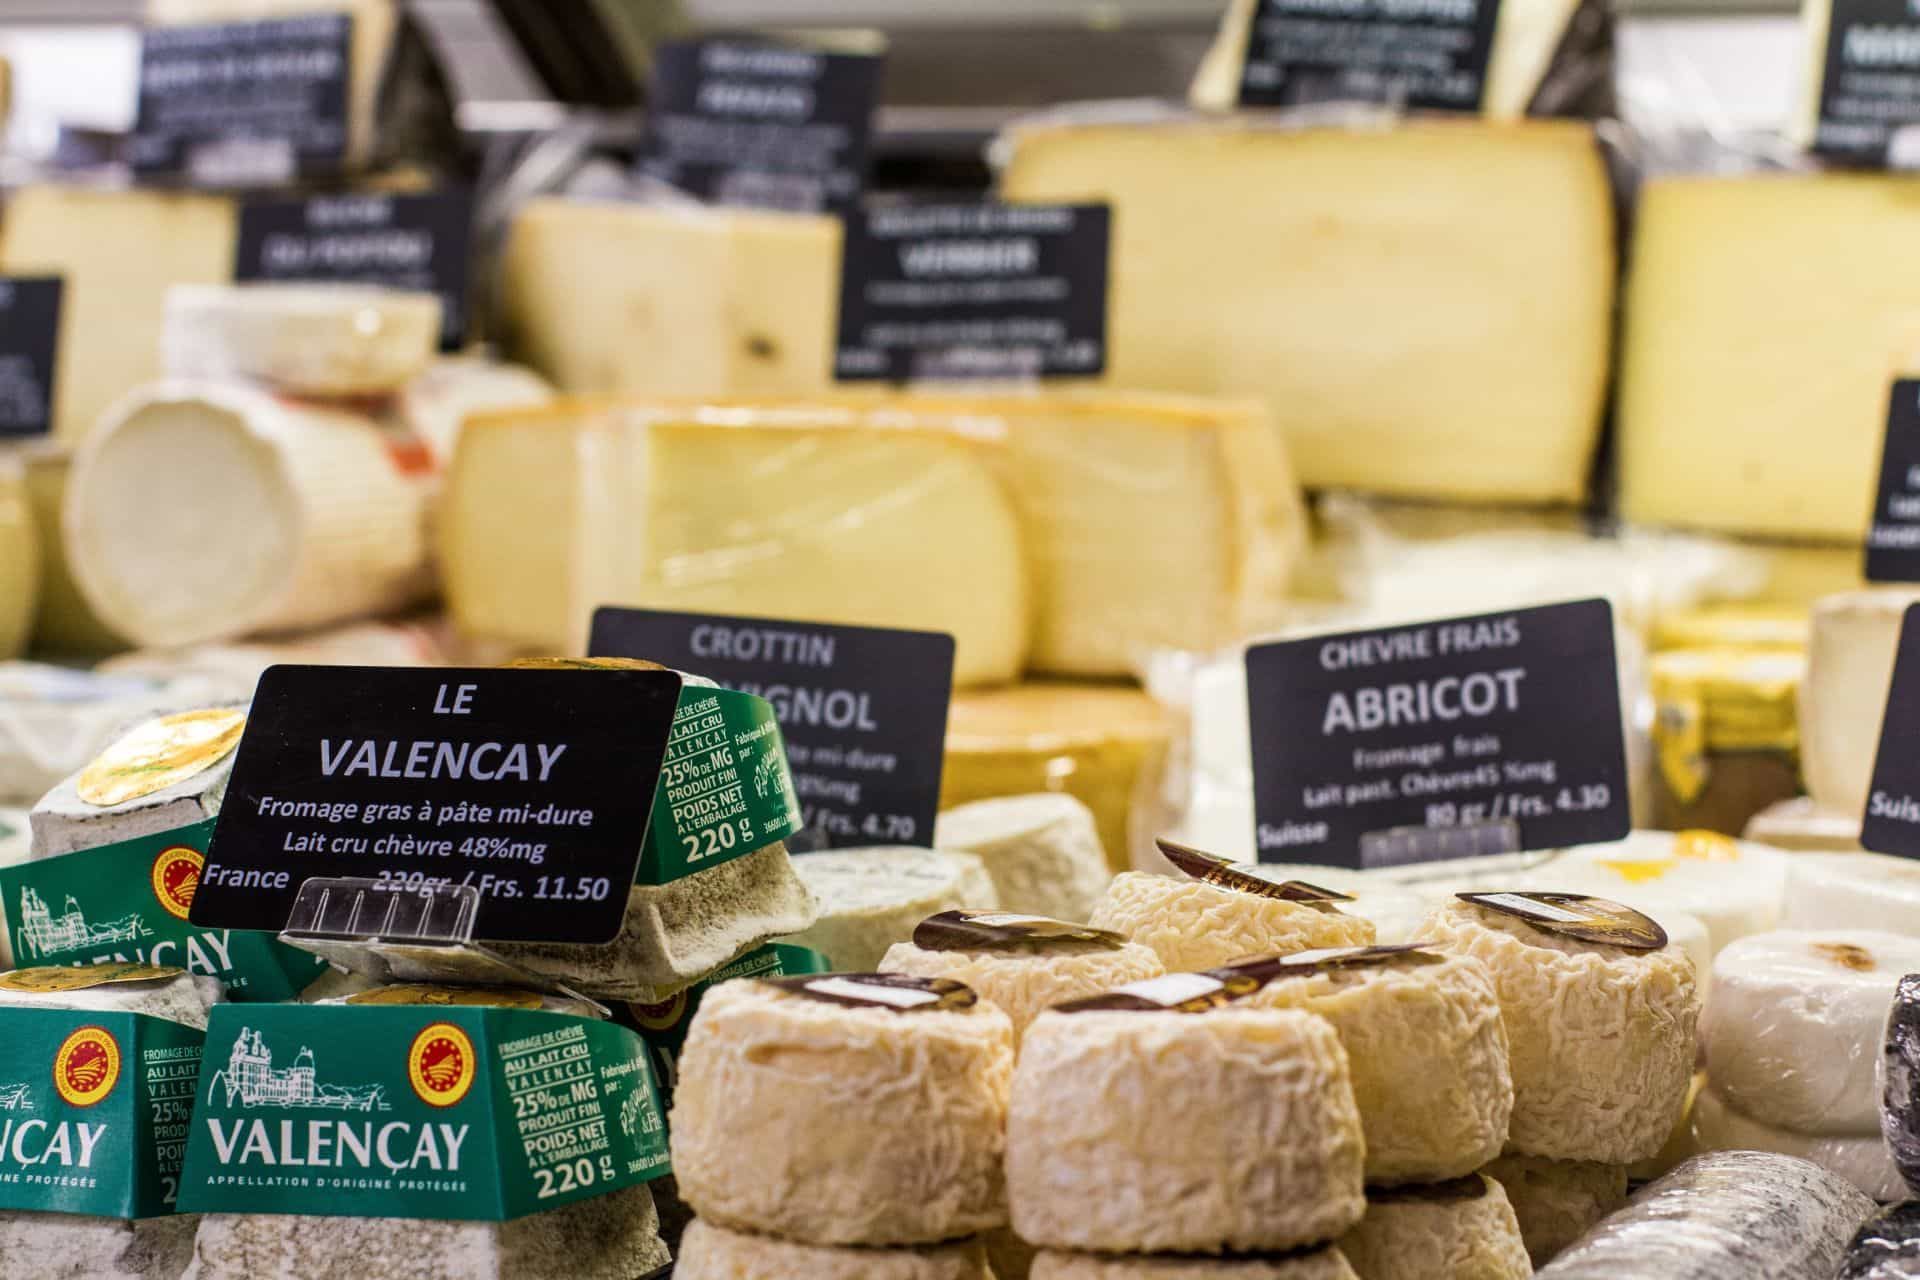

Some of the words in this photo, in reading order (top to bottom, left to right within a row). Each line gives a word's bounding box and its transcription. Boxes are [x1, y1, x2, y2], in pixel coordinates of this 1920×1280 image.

[690, 624, 835, 666] CROTTIN
[1438, 618, 1521, 656] FRAIS
[433, 683, 478, 715] LE
[685, 705, 695, 716] DE
[1322, 668, 1526, 734] ABRICOT
[674, 721, 699, 738] LAIT
[701, 713, 723, 729] CRU
[320, 739, 566, 781] VALENCAY
[667, 728, 728, 760] ALENÇAY
[662, 760, 700, 788] 25%
[701, 762, 712, 775] DE
[711, 747, 734, 771] MG
[667, 773, 717, 803] PRODUIT
[719, 768, 738, 783] FINI
[258, 796, 359, 823] Fromage
[362, 805, 412, 825] gras
[417, 799, 433, 822] à
[437, 800, 493, 826] pâte
[498, 802, 594, 826] mi-dure
[672, 795, 719, 823] POIDS
[719, 784, 743, 804] NET
[283, 831, 326, 853] Lait
[330, 836, 368, 854] cru
[373, 834, 453, 856] chèvre
[458, 837, 548, 865] 48%mg
[681, 822, 736, 863] 220
[739, 817, 754, 842] g
[1259, 821, 1329, 849] Suisse
[203, 864, 290, 890] France
[373, 870, 452, 898] 220gr
[453, 871, 474, 900] /
[478, 873, 524, 899] Frs.
[533, 875, 610, 901] 11.50
[144, 1048, 184, 1060] FROMAGE
[504, 1057, 527, 1073] AU
[528, 1048, 560, 1068] LAIT
[563, 1043, 589, 1059] CRU
[148, 1067, 167, 1079] AU
[169, 1066, 197, 1077] LAIT
[507, 1060, 593, 1091] VALENÇAY
[152, 1102, 188, 1123] 25%
[513, 1090, 557, 1119] 25%
[571, 1079, 598, 1101] MG
[518, 1107, 577, 1134] PRODUIT
[579, 1102, 601, 1118] FINI
[207, 1118, 469, 1176] VALENÇAY
[523, 1129, 577, 1156] POIDS
[579, 1120, 607, 1140] NET
[26, 1174, 97, 1188] PROTÉGÉE
[207, 1175, 310, 1187] APPELLATION
[317, 1177, 392, 1190] D'ORIGINE
[399, 1179, 467, 1192] PROTÉGÉE
[533, 1158, 595, 1199] 220
[599, 1154, 616, 1181] g
